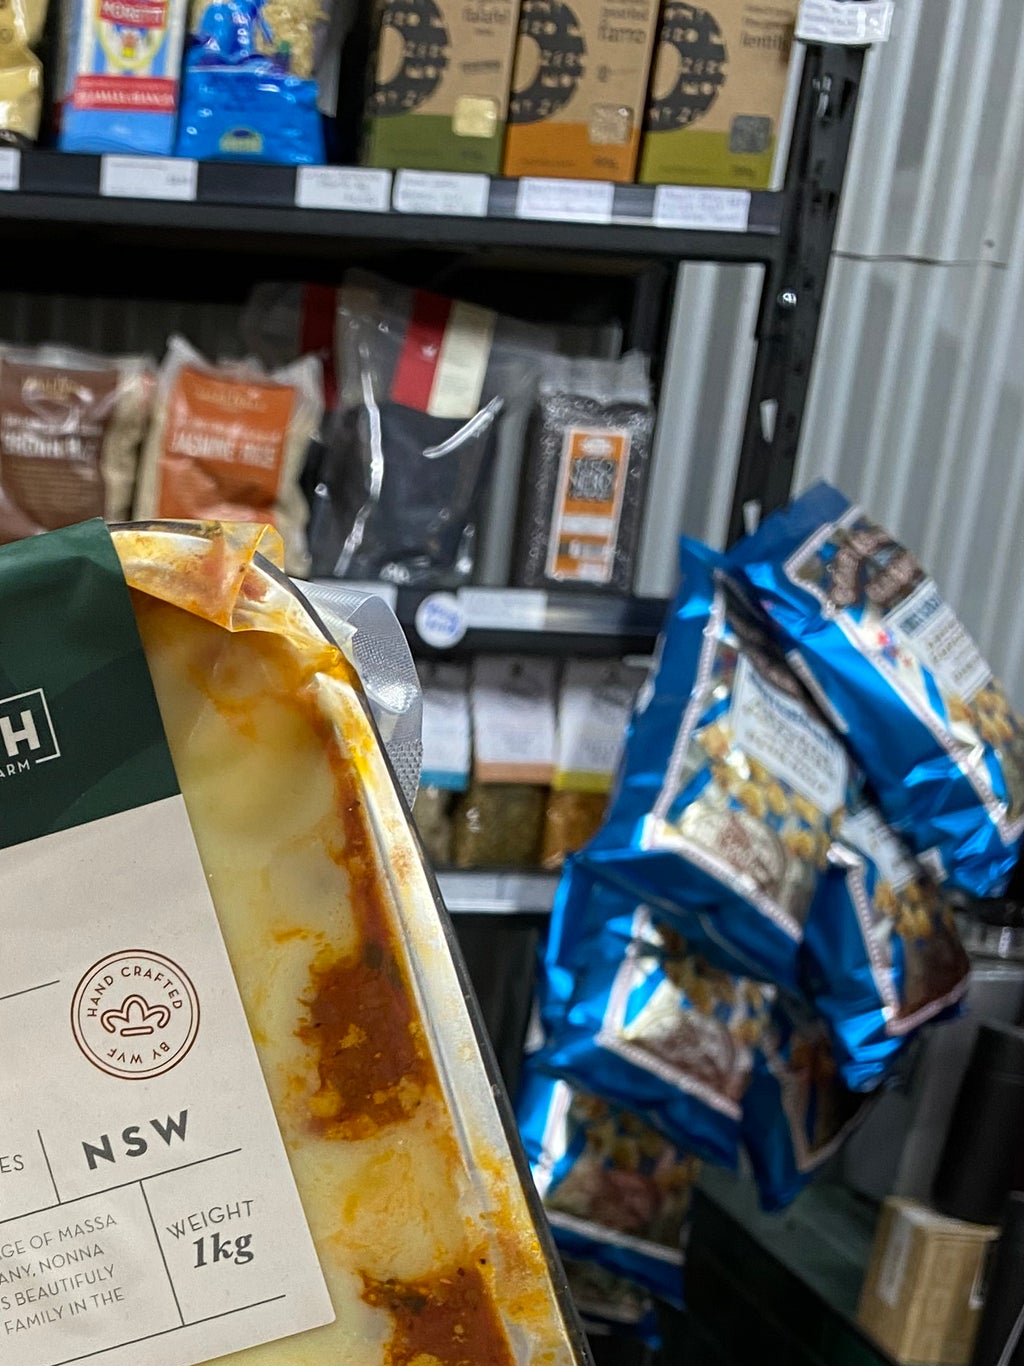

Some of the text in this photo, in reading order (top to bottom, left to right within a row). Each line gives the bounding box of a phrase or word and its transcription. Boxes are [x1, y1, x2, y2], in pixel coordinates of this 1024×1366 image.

[87, 965, 183, 1017] HAND CRAFTED
[107, 1041, 170, 1064] BY WVF
[81, 1108, 188, 1170] NSW
[29, 1231, 52, 1249] OF
[57, 1213, 117, 1242] MASSA
[165, 1199, 254, 1239] WEIGHT
[38, 1242, 104, 1273] NONNA
[192, 1231, 254, 1269] 1kg
[13, 1263, 114, 1306] BEAUTIFULY
[3, 1305, 63, 1334] FAMILY
[68, 1298, 87, 1316] IN
[88, 1286, 125, 1307] THE
